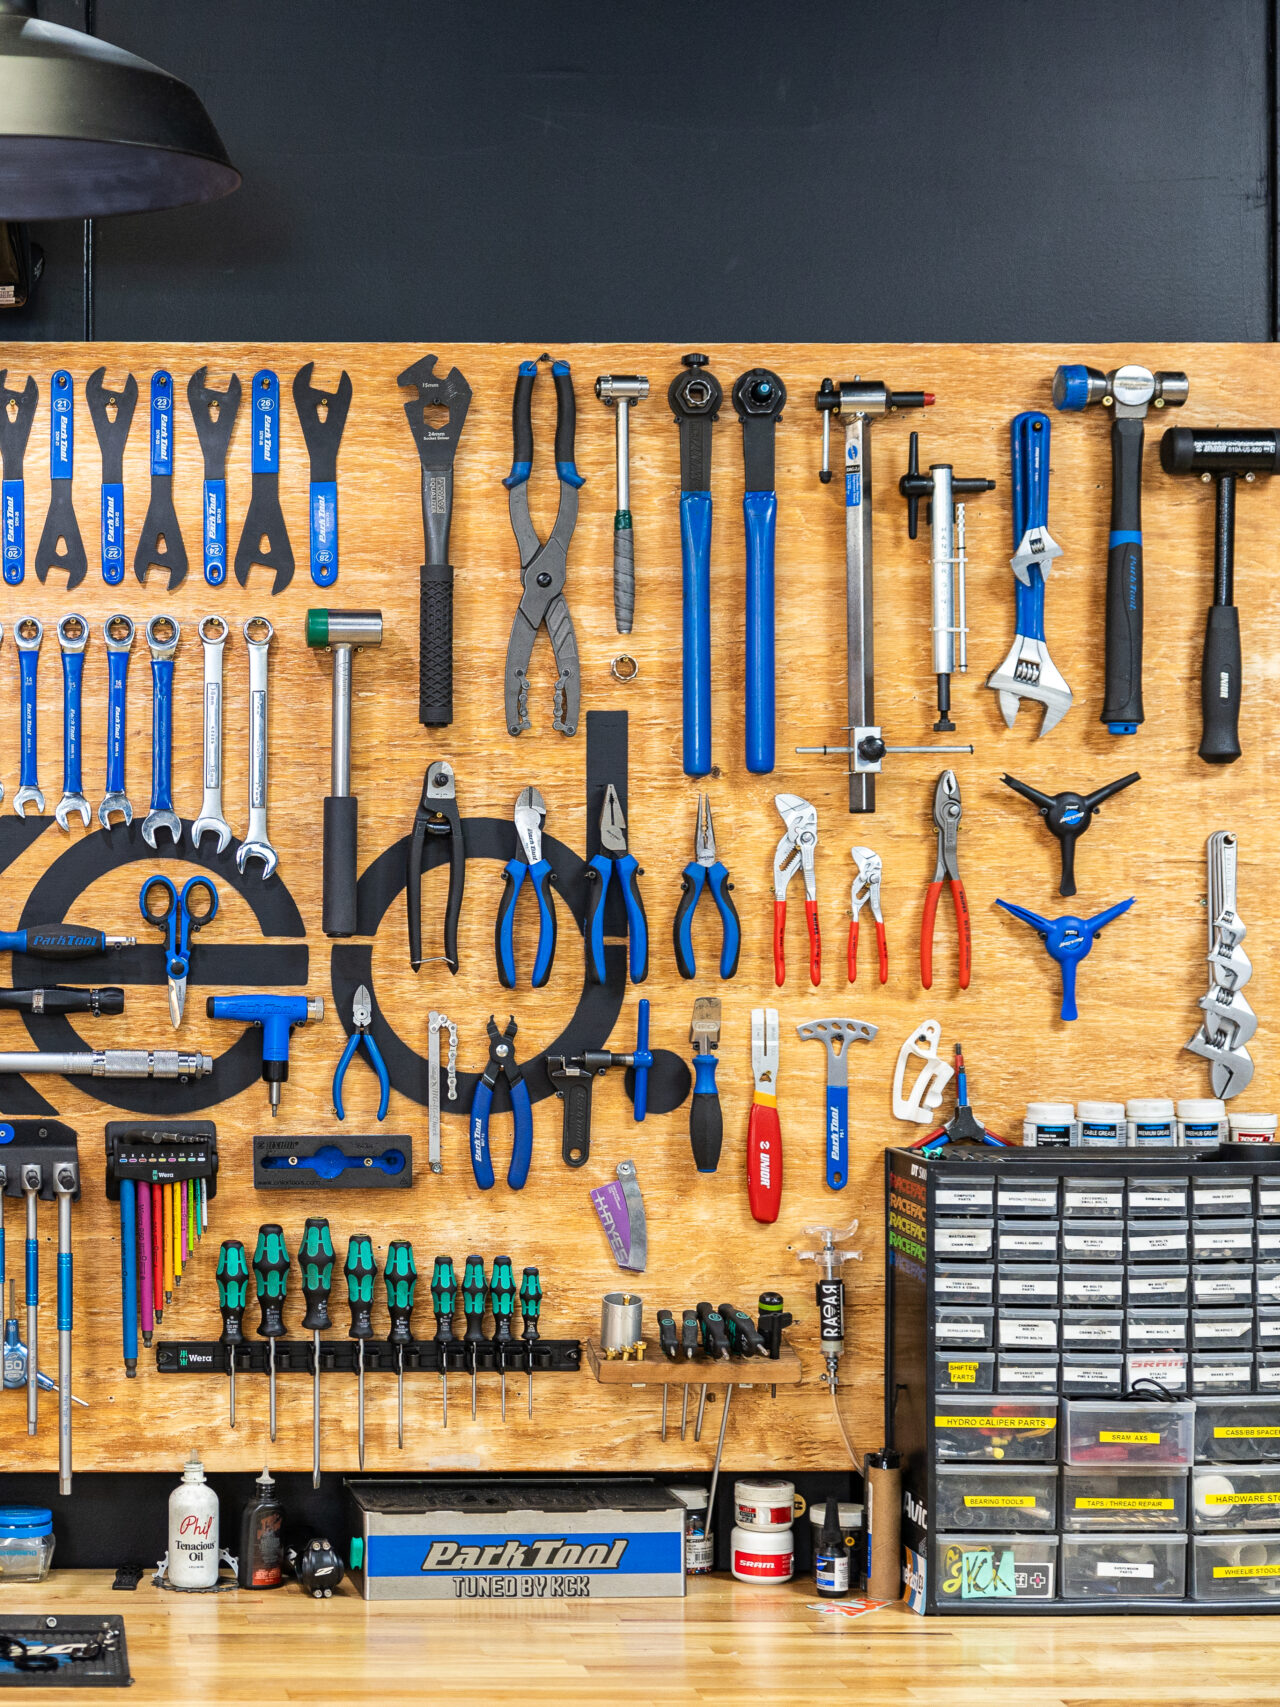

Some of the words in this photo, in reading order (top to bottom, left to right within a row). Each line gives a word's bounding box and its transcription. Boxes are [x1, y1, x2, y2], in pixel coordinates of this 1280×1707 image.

[760, 1153, 770, 1187] UNIOR
[594, 1191, 629, 1263] HAYES
[189, 1354, 212, 1362] Wera
[4, 1360, 22, 1369] 50
[1130, 1360, 1184, 1368] SRAM
[180, 1515, 214, 1540] Phil
[175, 1540, 216, 1550] Tenacious
[188, 1552, 204, 1562] Oil
[739, 1560, 775, 1569] SRAM
[453, 1576, 518, 1598] TUNED
[520, 1576, 547, 1597] BY
[550, 1576, 590, 1596] KCK
